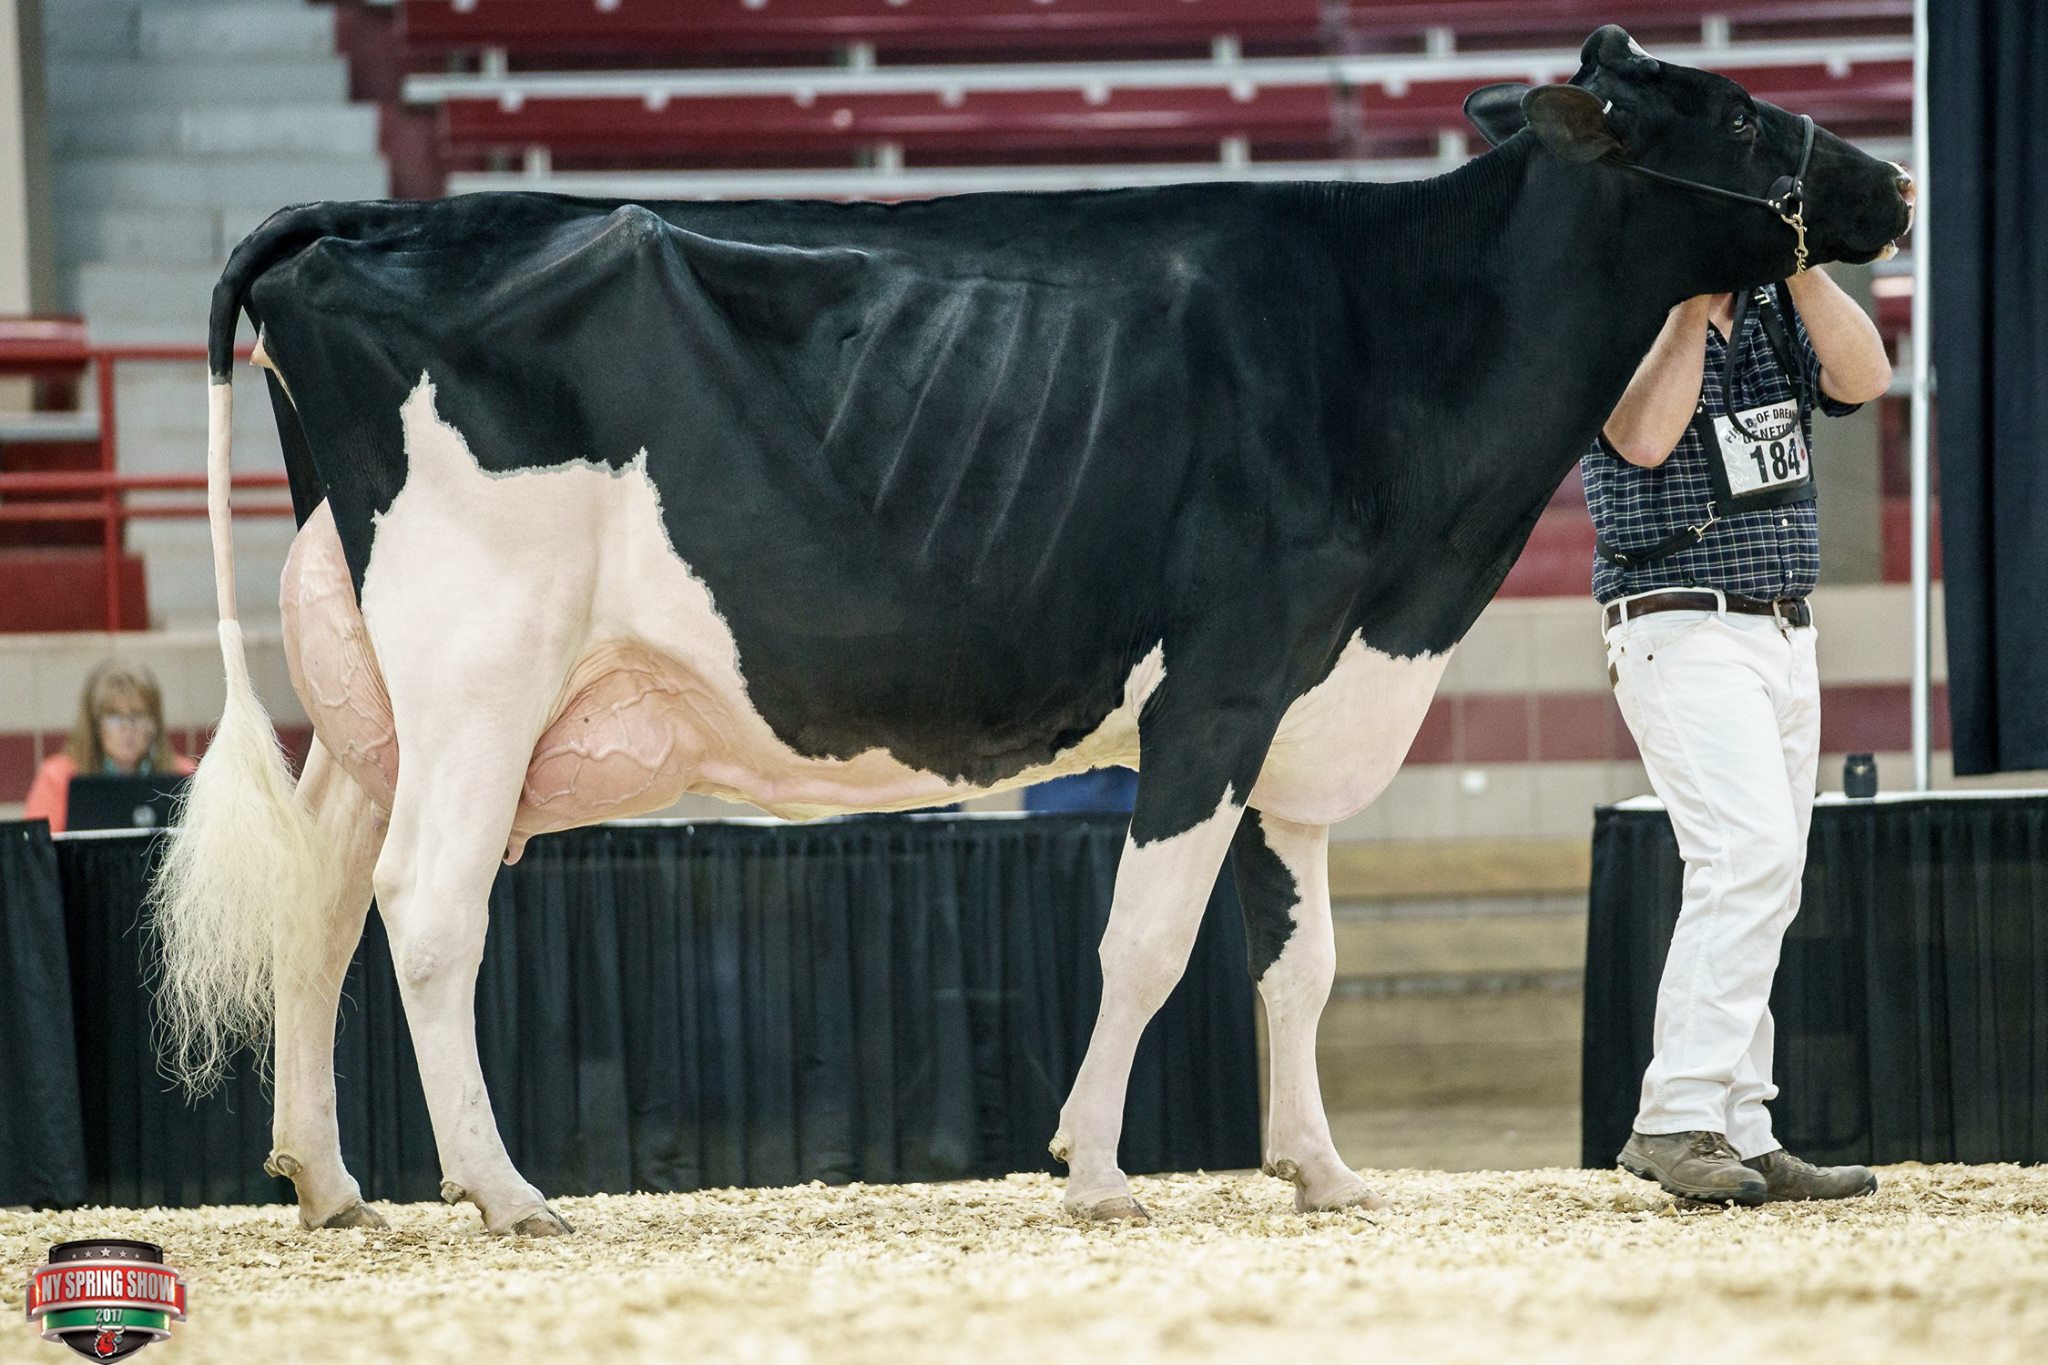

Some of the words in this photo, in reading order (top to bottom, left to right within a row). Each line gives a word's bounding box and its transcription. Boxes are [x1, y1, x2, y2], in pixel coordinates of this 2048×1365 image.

[1756, 410, 1770, 423] OF
[1772, 408, 1796, 420] DREA
[1743, 421, 1795, 444] GENETI
[1749, 437, 1800, 484] 184
